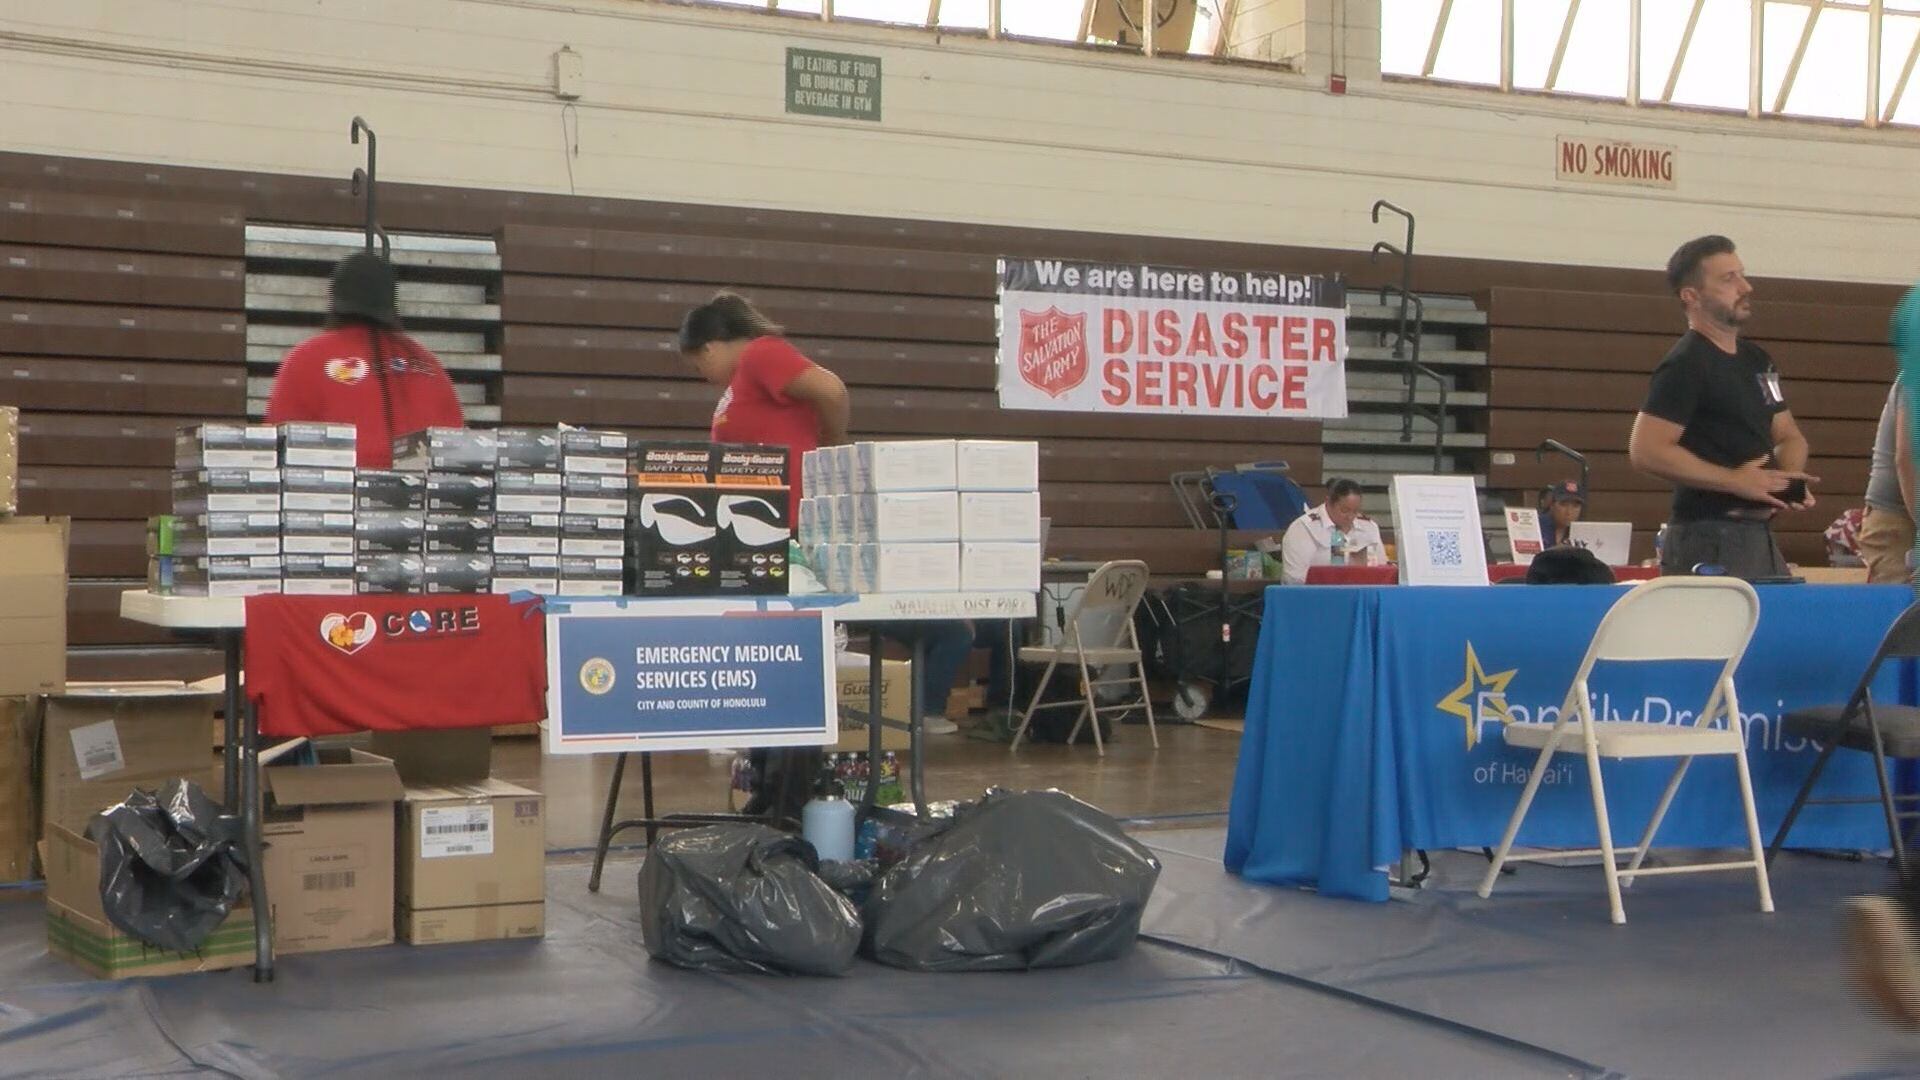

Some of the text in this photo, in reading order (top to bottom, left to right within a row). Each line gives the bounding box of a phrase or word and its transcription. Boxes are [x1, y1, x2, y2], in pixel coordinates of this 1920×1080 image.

[792, 55, 877, 78] NO EATING OF FOOD
[799, 73, 869, 94] OR DRINKING OF
[794, 89, 872, 112] BEVERAGE IN GYM
[1563, 142, 1672, 181] NO SMOKING
[1034, 260, 1311, 302] We are here to help!
[1032, 316, 1058, 343] THE
[1102, 308, 1337, 361] DISASTER
[1023, 321, 1081, 373] SALVATION
[1043, 345, 1080, 385] ARMY
[1101, 358, 1309, 411] SERVICE
[681, 465, 708, 473] GEAR
[757, 467, 784, 475] GEAR
[383, 606, 481, 636] CORE
[636, 645, 803, 665] EMERGENCY MEDICAL
[636, 671, 707, 690] SERVICES
[711, 669, 757, 690] (EMS)
[843, 681, 889, 696] Guad
[637, 697, 767, 711] CITY AND COUNTY OF HONOLULU
[1474, 762, 1498, 784] of
